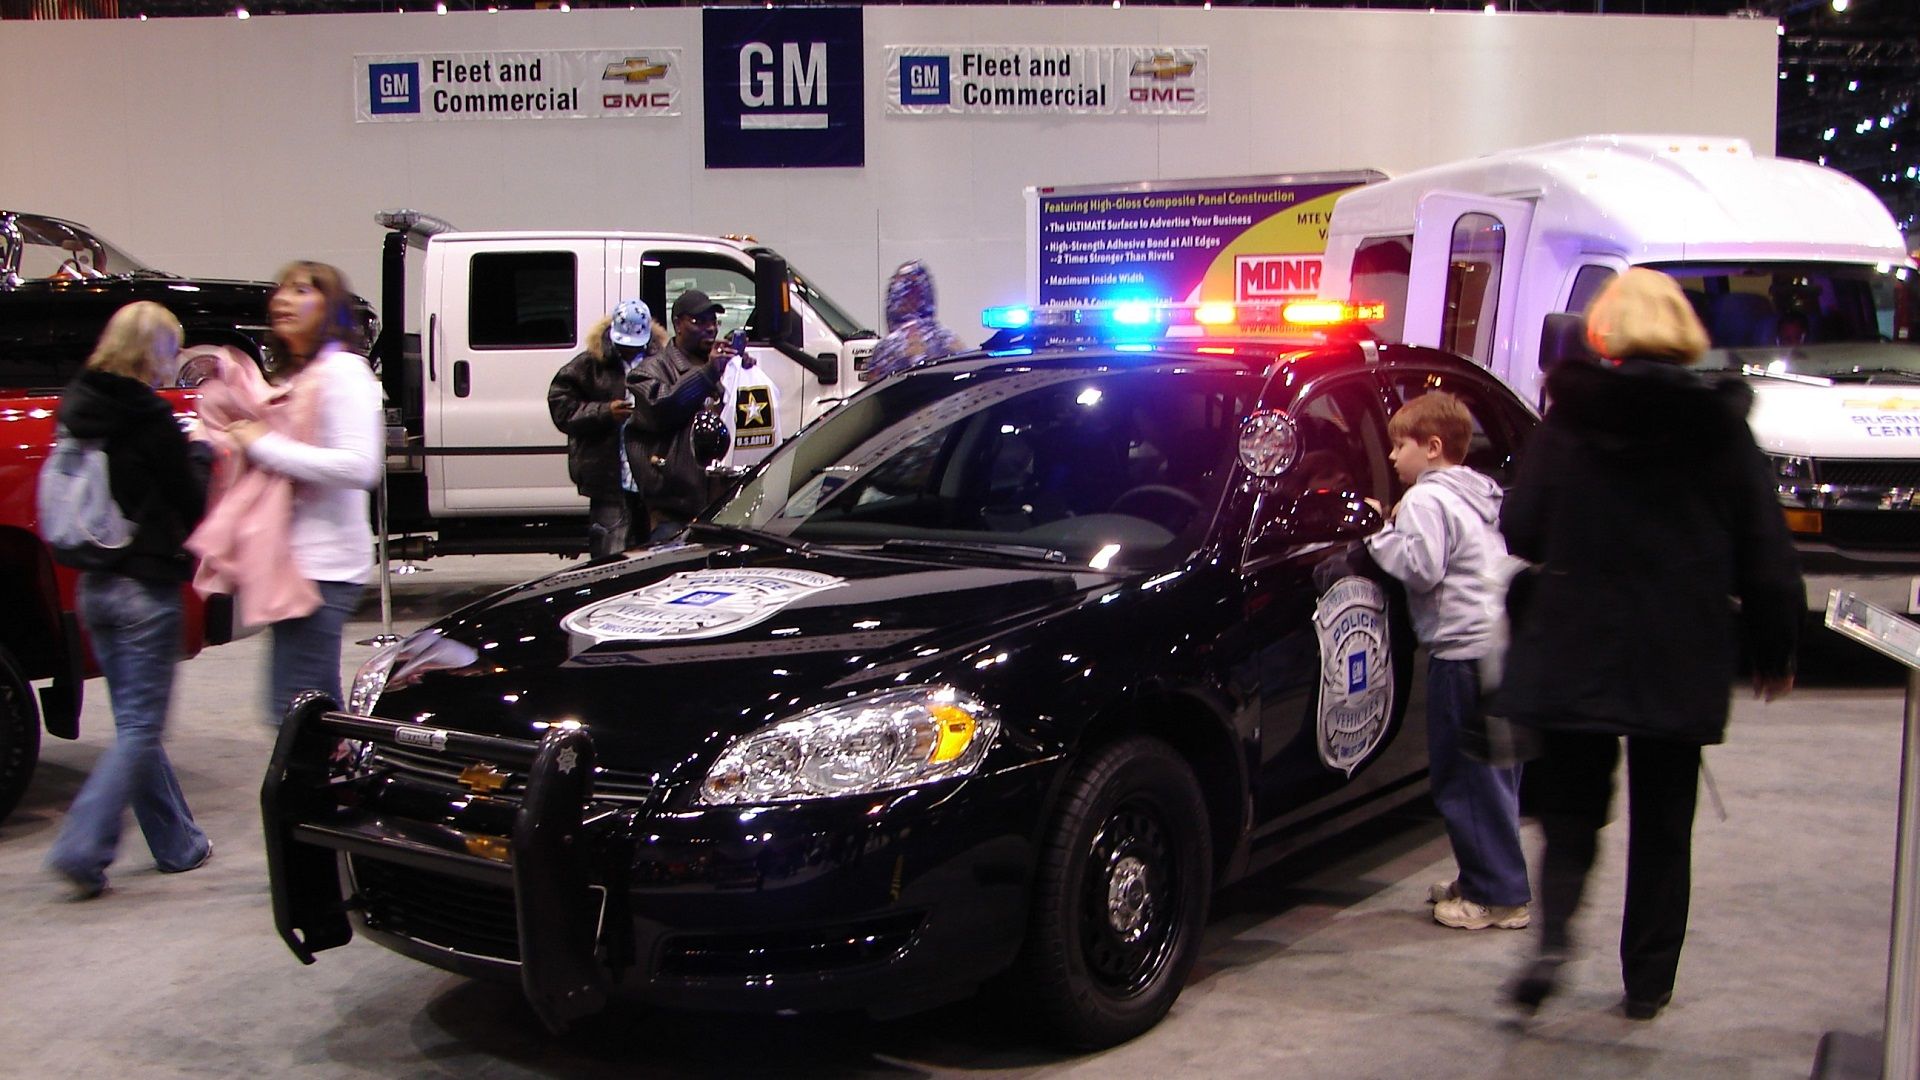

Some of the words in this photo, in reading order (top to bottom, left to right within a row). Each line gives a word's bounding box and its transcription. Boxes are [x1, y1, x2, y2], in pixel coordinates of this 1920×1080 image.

[432, 60, 491, 83] Fleet
[499, 58, 541, 82] and
[739, 41, 828, 107] GM
[910, 65, 939, 88] GM
[962, 54, 1021, 77] Fleet
[1029, 54, 1071, 76] and
[380, 73, 409, 96] GM
[963, 83, 1106, 106] Commercial
[1129, 88, 1195, 102] GMC
[433, 88, 578, 113] Commercial
[602, 93, 670, 109] GMC
[1045, 201, 1088, 214] Featuring
[1090, 197, 1141, 213] High-Gloss
[1143, 195, 1195, 210] Composite
[1198, 193, 1226, 206] Panel
[1228, 190, 1295, 204] Construction
[1050, 221, 1065, 233] The
[1066, 220, 1106, 232] ULTIMATE
[1107, 218, 1138, 231] Surface
[1140, 218, 1149, 229] to
[1149, 216, 1191, 228] Advertise
[1191, 215, 1212, 227] Your
[1213, 214, 1251, 226] Business
[1297, 212, 1321, 225] MTE
[1049, 240, 1105, 253] High-Strength
[1107, 238, 1146, 250] Adhesive
[1147, 236, 1169, 249] Bond
[1170, 237, 1179, 248] at
[1181, 235, 1193, 247] All
[1194, 234, 1220, 249] Edges
[1063, 253, 1088, 264] Times
[1089, 252, 1125, 265] Stronger
[1125, 250, 1147, 262] Than
[1049, 275, 1090, 286] Maximum
[1091, 273, 1117, 285] Inside
[1119, 272, 1144, 284] Width
